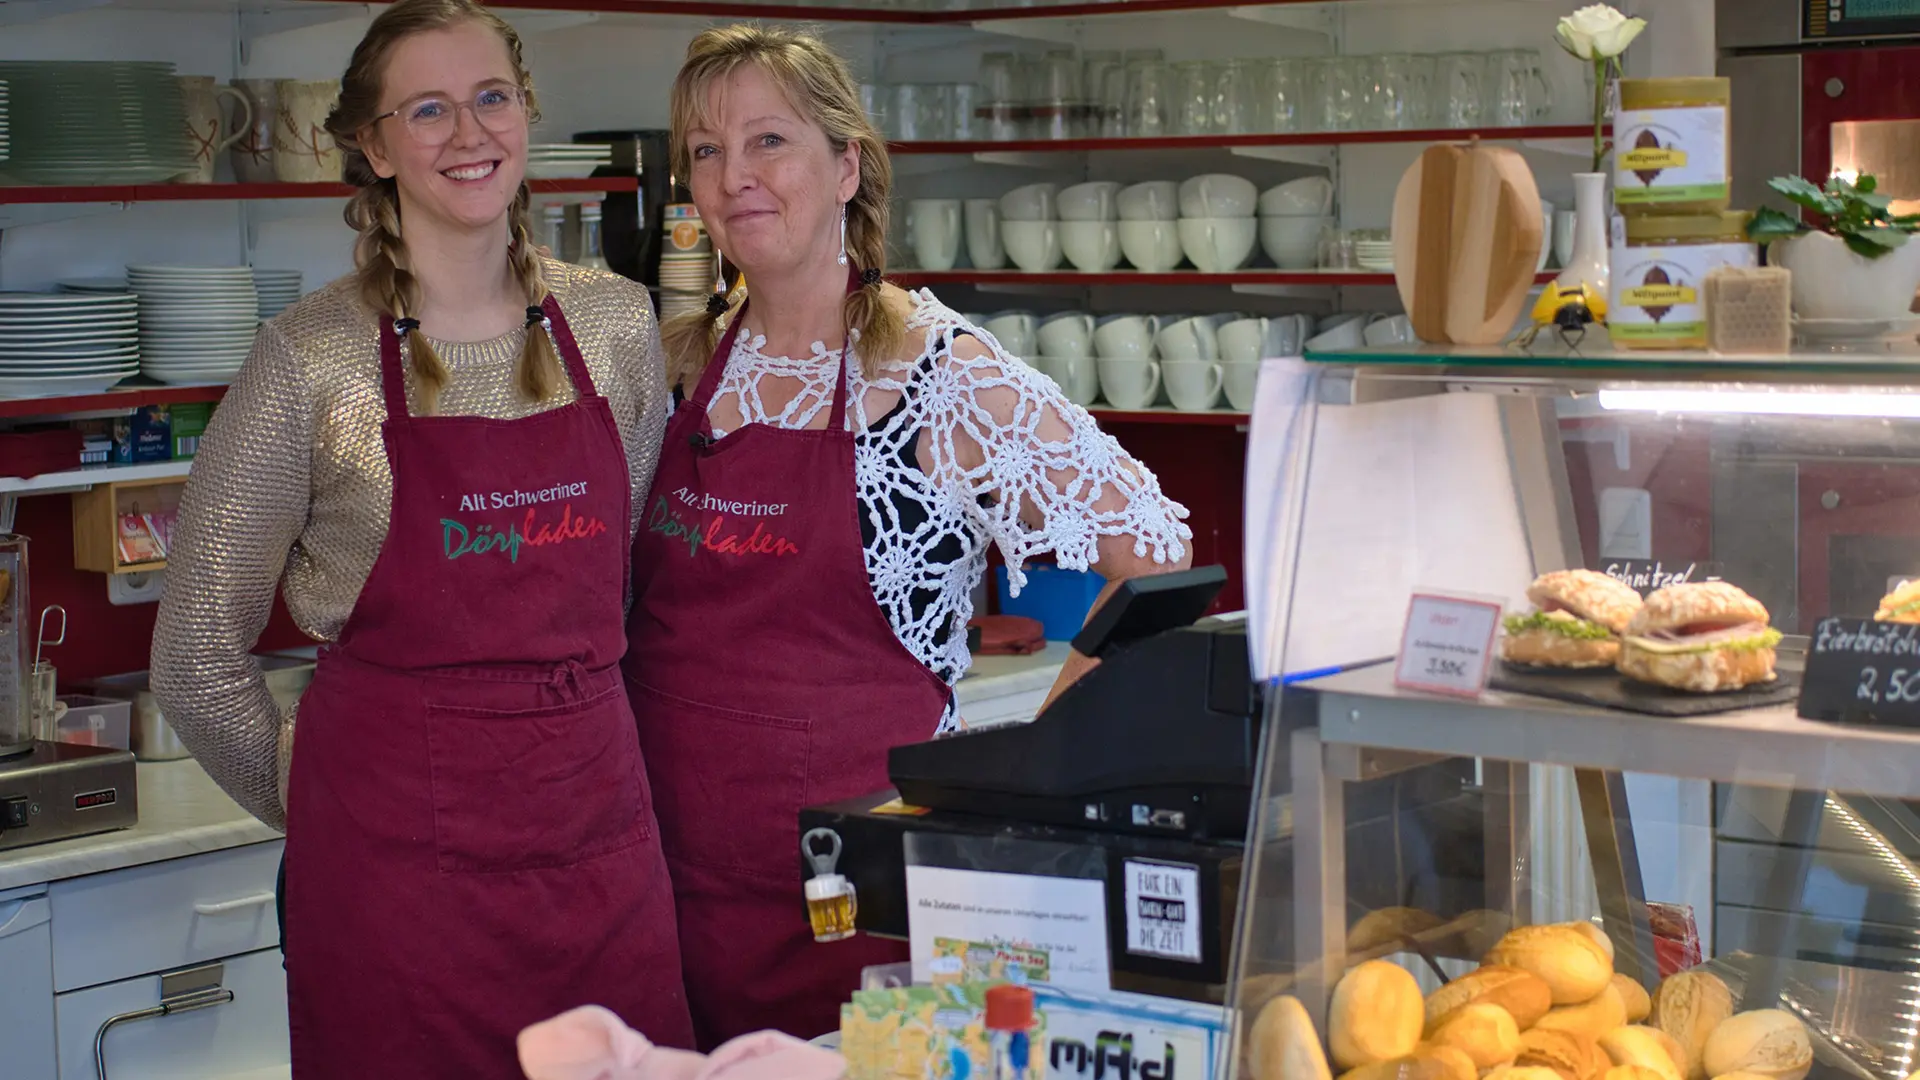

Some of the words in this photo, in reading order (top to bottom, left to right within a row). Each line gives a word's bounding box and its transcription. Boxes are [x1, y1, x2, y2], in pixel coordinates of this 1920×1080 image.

[459, 493, 487, 511] Alt
[490, 480, 587, 509] Schweriner
[672, 486, 697, 507] Alt
[697, 492, 788, 516] hweriner
[440, 503, 606, 563] Dörpladen
[1159, 930, 1184, 952] ZEIT
